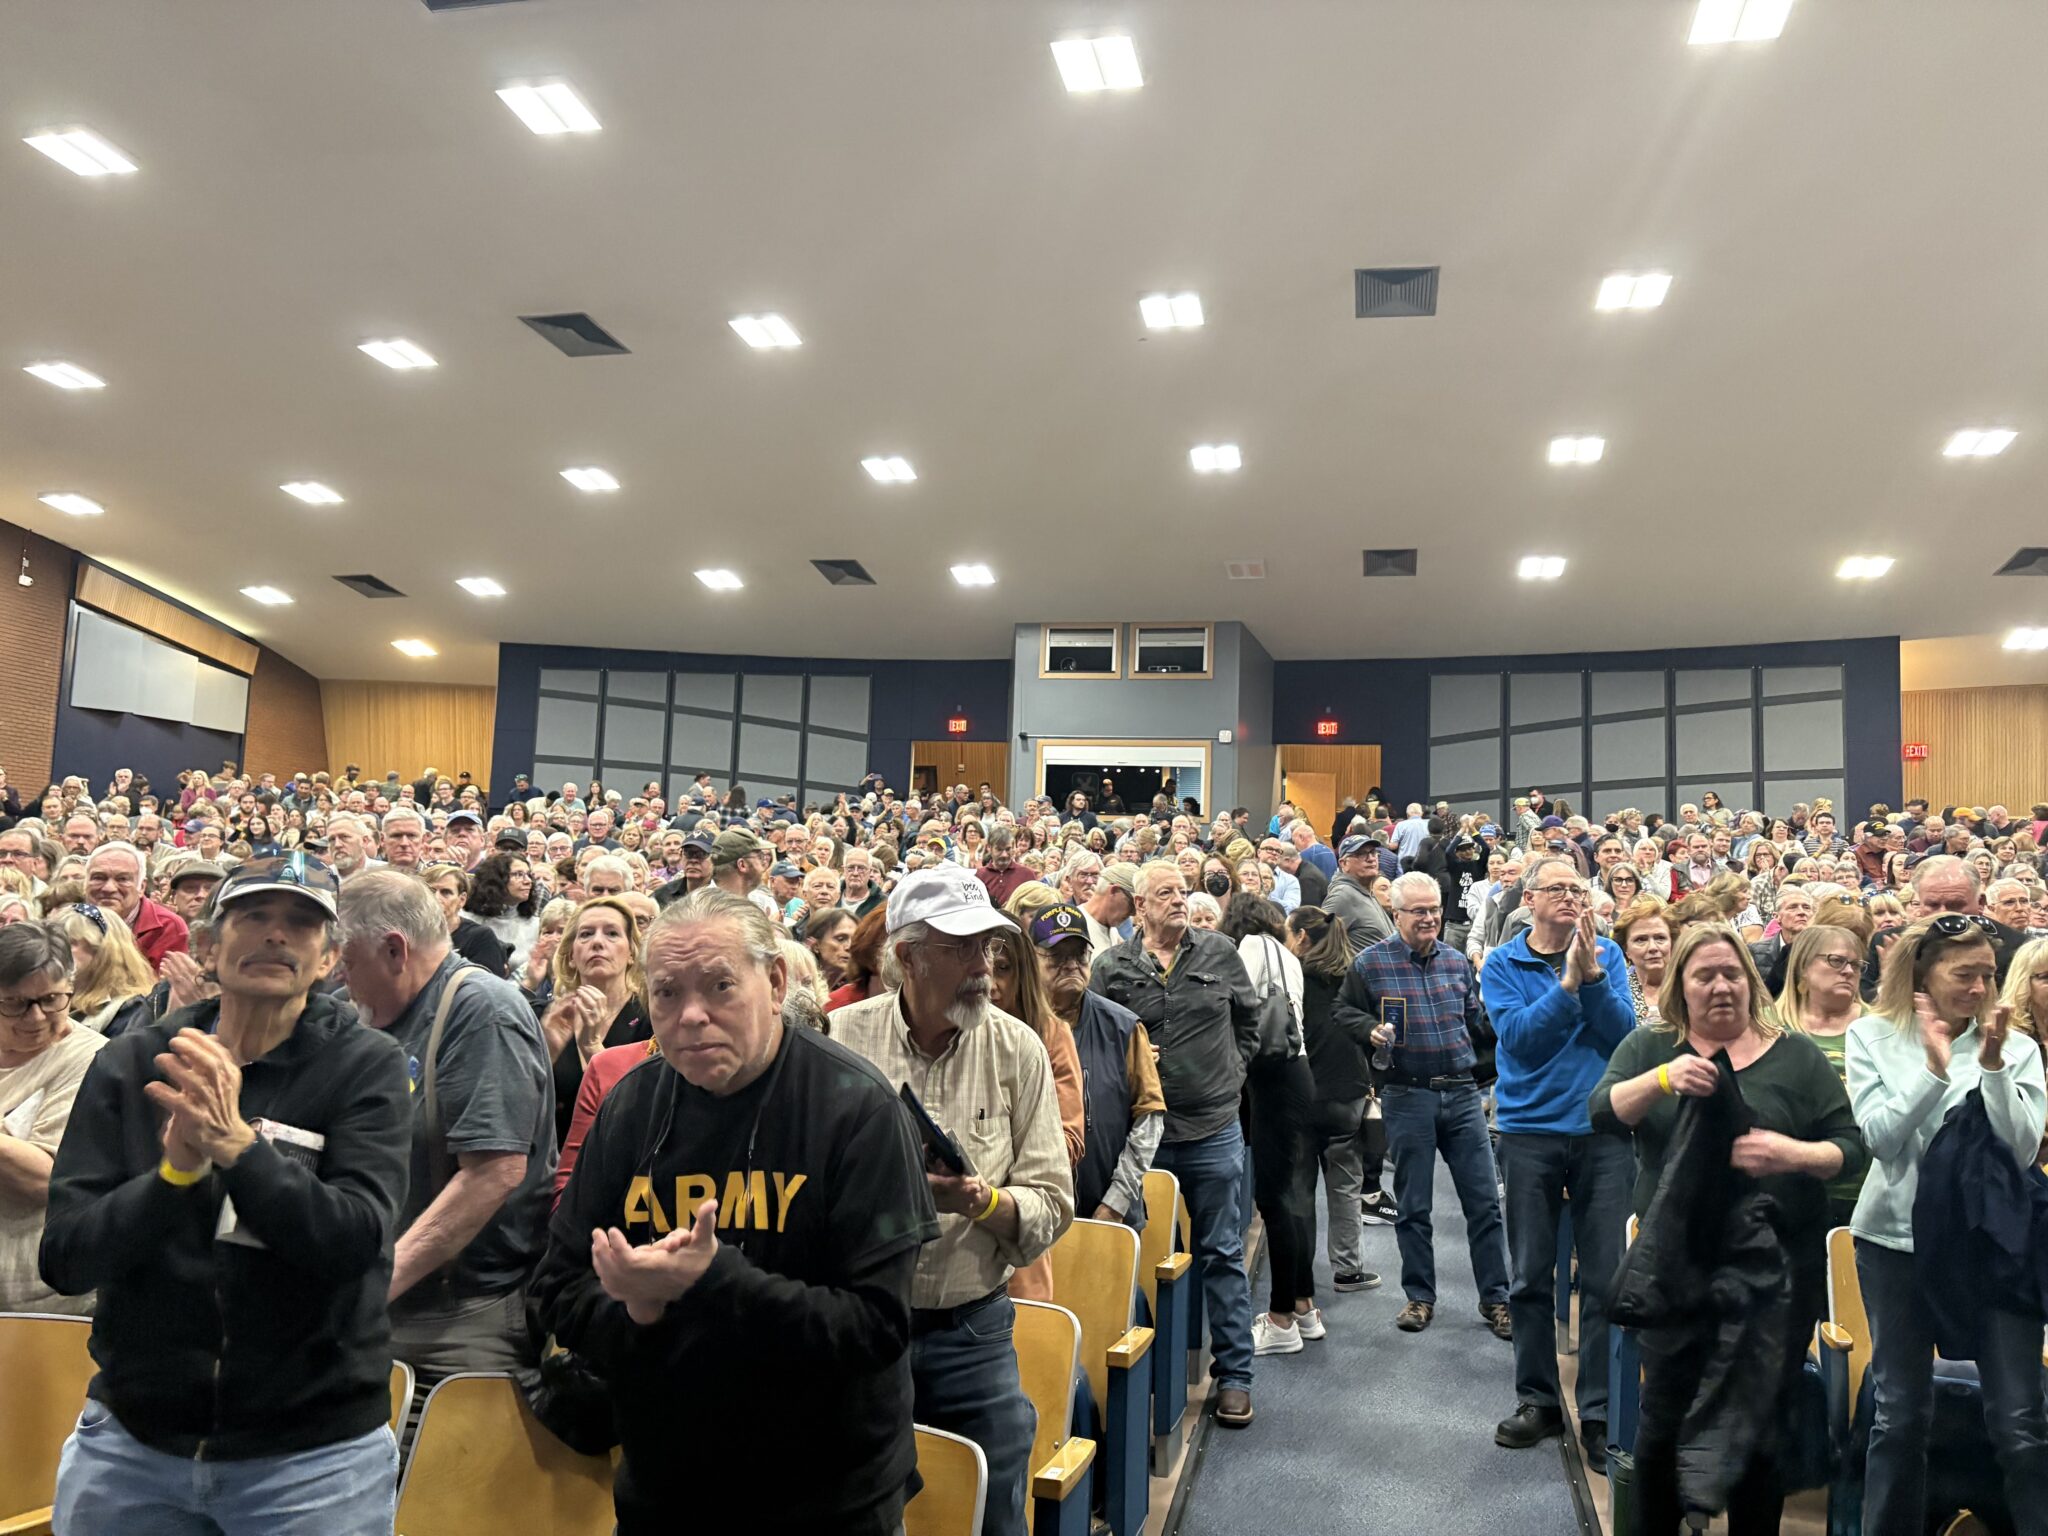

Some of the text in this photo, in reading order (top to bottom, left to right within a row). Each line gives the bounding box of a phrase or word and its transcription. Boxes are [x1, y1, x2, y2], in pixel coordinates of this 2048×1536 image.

[952, 720, 966, 731] EXIT
[1321, 723, 1336, 734] EXIT
[1909, 745, 1927, 757] EXIT
[963, 889, 984, 903] kind
[624, 1170, 808, 1233] ARMY
[1378, 1206, 1399, 1217] HOKA
